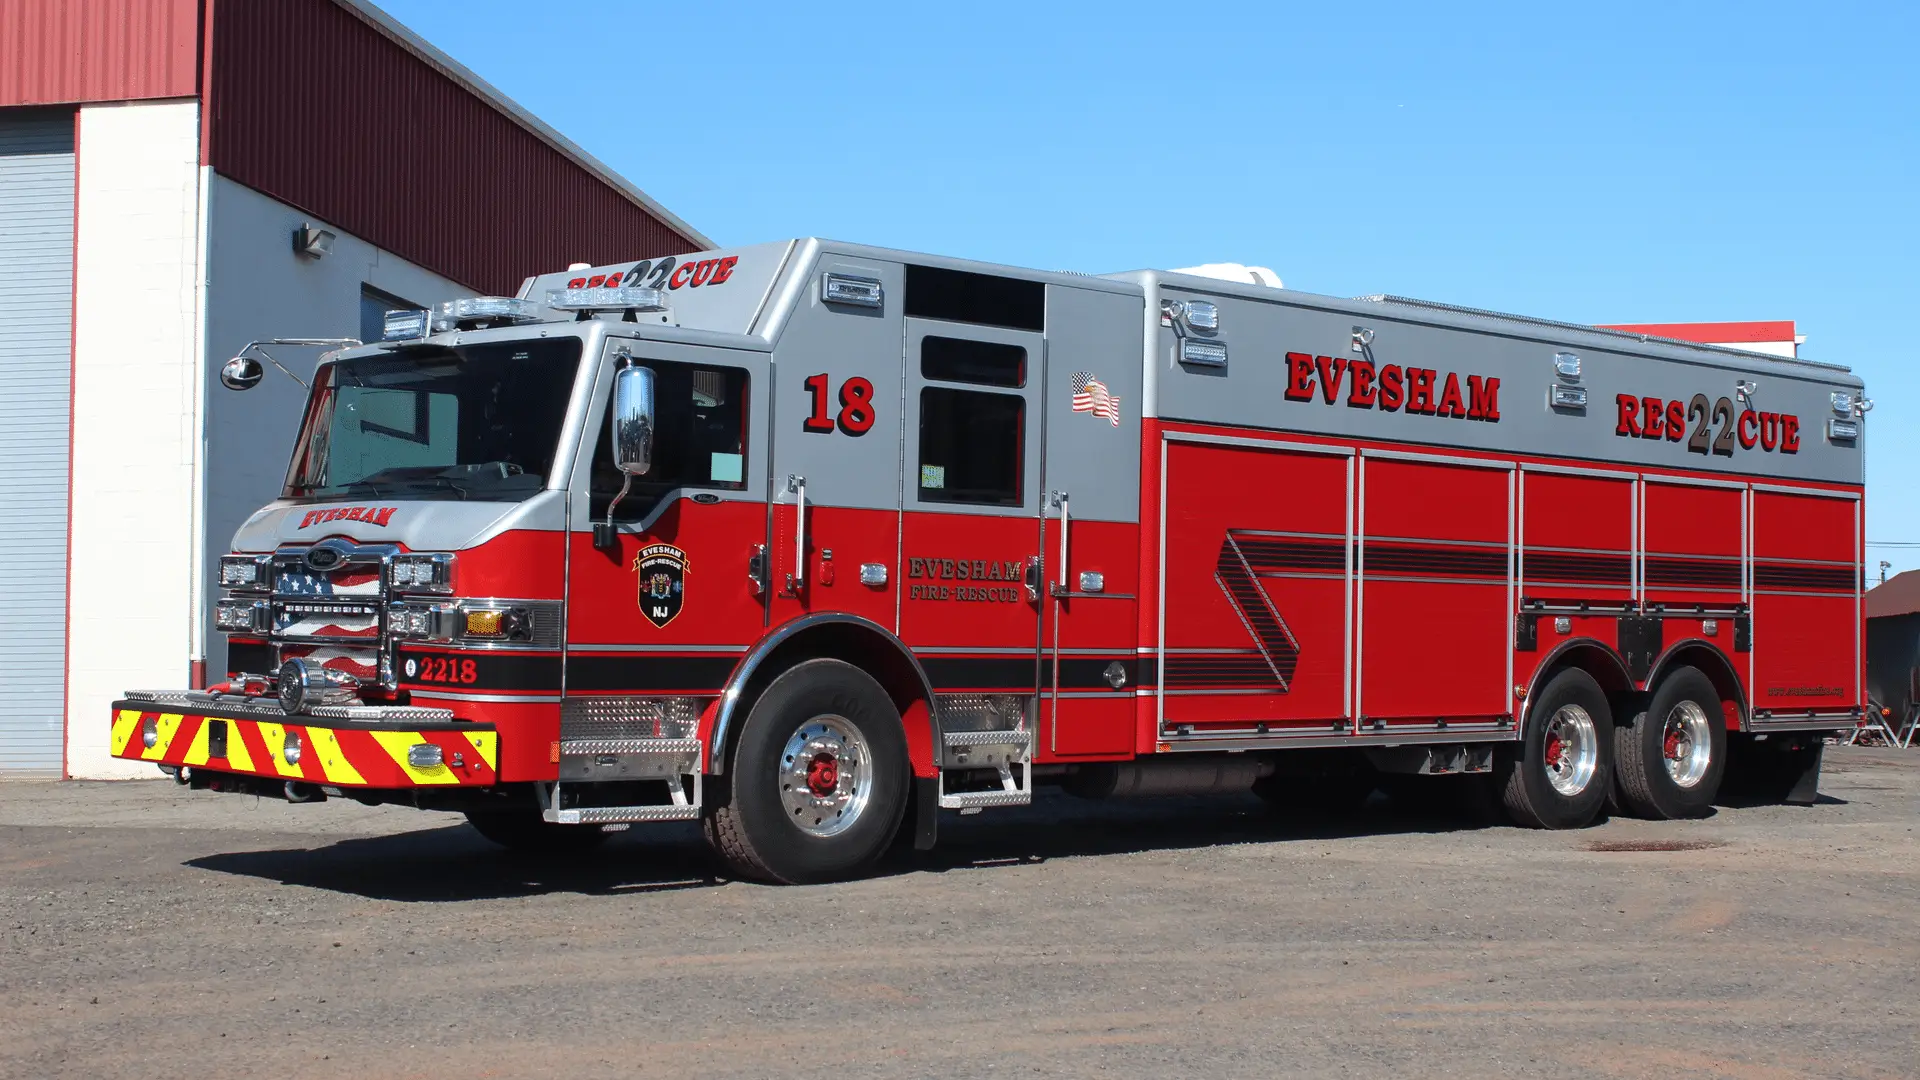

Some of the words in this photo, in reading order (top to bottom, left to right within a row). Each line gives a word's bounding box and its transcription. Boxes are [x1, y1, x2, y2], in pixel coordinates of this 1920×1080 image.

[1284, 351, 1500, 423] EVESHAM
[803, 372, 875, 437] 18
[1615, 393, 1800, 458] RES22CUE
[298, 507, 398, 530] EVESHAM
[641, 558, 682, 570] FIRE-RESCUE
[642, 546, 681, 558] EVESHAM
[908, 557, 1021, 582] EVESHAM
[910, 585, 1018, 602] FIRE-RESCUE
[653, 606, 668, 617] NJ
[421, 656, 477, 683] 2218
